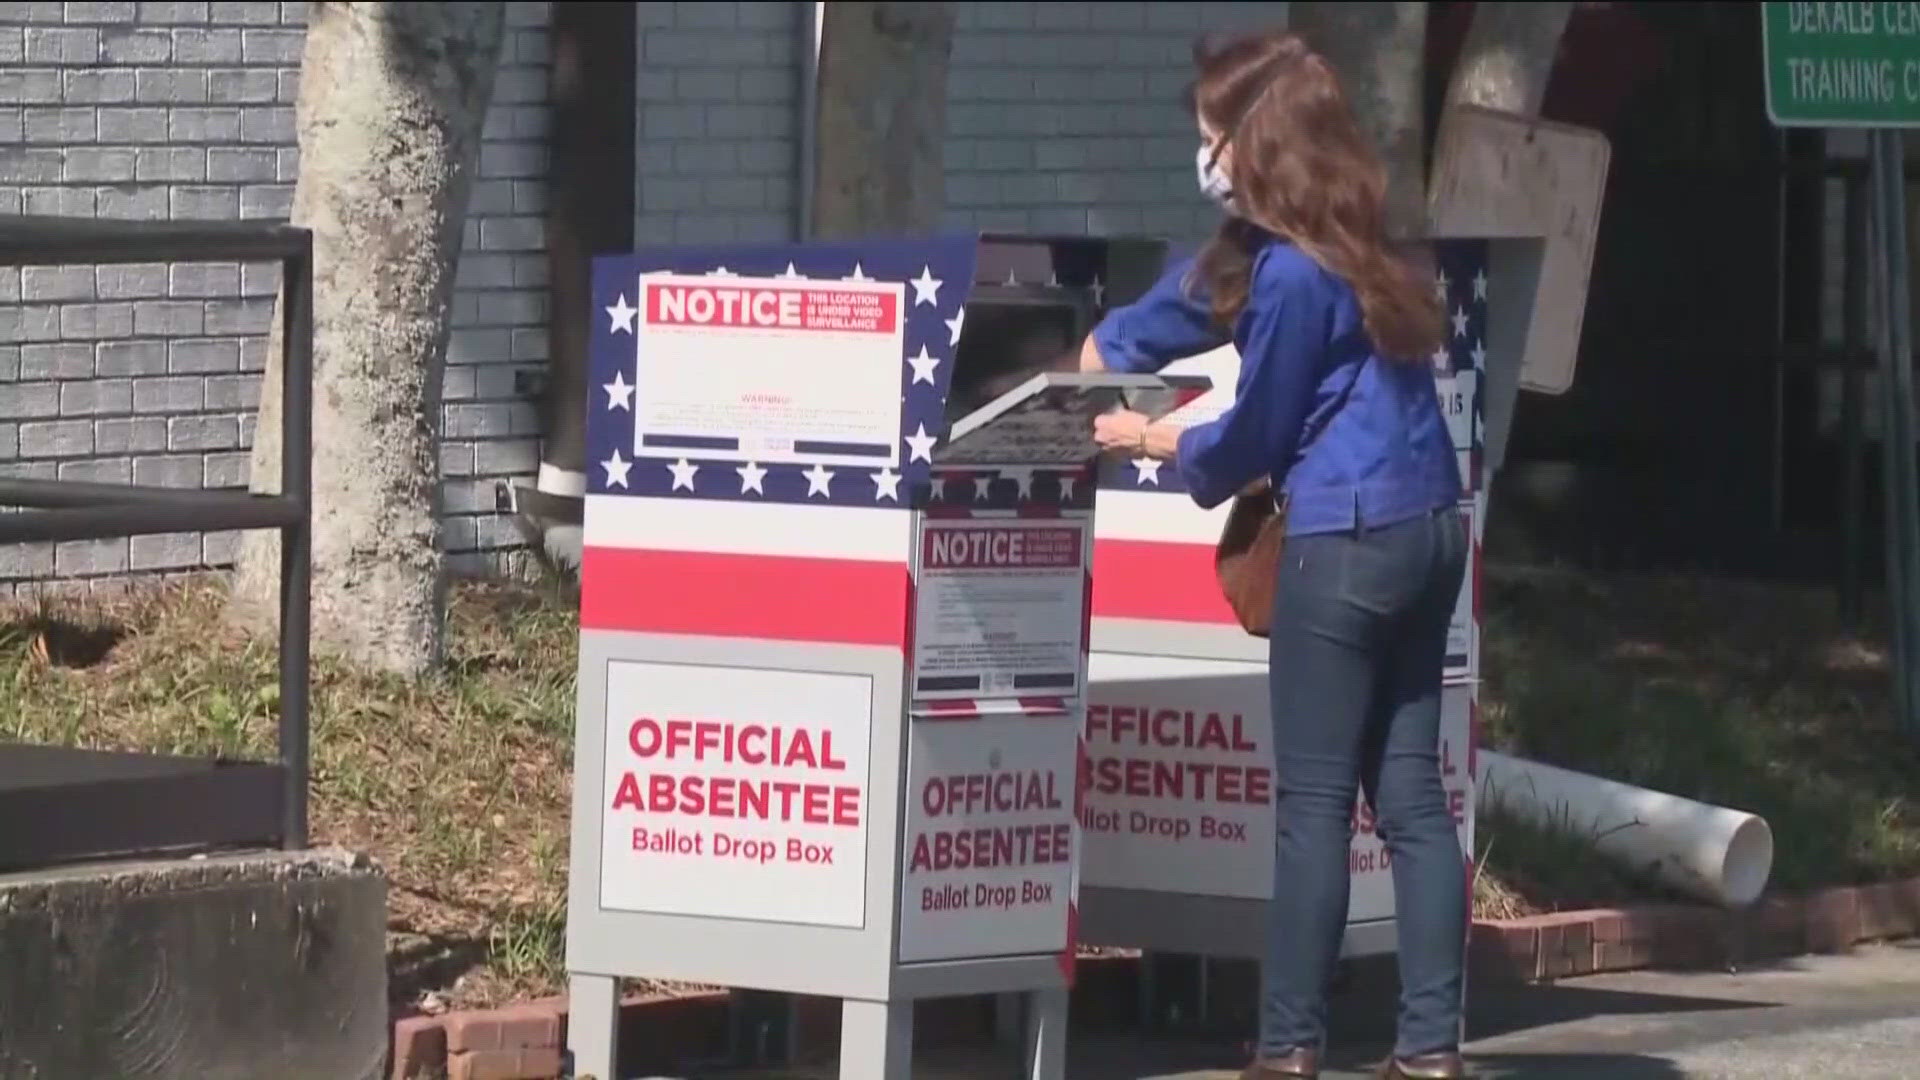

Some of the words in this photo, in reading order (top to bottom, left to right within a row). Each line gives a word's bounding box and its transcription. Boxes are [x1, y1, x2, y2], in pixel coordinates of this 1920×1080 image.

[1789, 2, 1875, 34] DEKALB
[1788, 59, 1896, 103] TRAINING
[659, 287, 801, 326] NOTICE
[807, 293, 828, 304] THIS
[830, 293, 879, 306] LOCATION
[807, 305, 816, 315] IS
[818, 305, 851, 317] UNDER
[852, 307, 883, 319] VIDEO
[807, 317, 877, 330] SURVEILLANCE
[932, 532, 1024, 564] NOTICE
[629, 718, 846, 770] OFFICIAL
[1085, 705, 1257, 751] FFICIAL
[612, 772, 860, 826] ABSENTEE
[922, 769, 1062, 817] OFFICIAL
[1086, 757, 1271, 805] SENTEE
[1084, 807, 1120, 832] llot
[1129, 811, 1190, 842] Drop
[1201, 816, 1247, 841] Box
[632, 828, 703, 855] Ballot
[713, 832, 776, 864] Drop
[786, 839, 833, 864] Box
[910, 824, 1070, 873] ABSENTEE
[922, 883, 969, 911] Ballot
[975, 883, 1015, 911] Drop
[1021, 880, 1052, 903] Box
